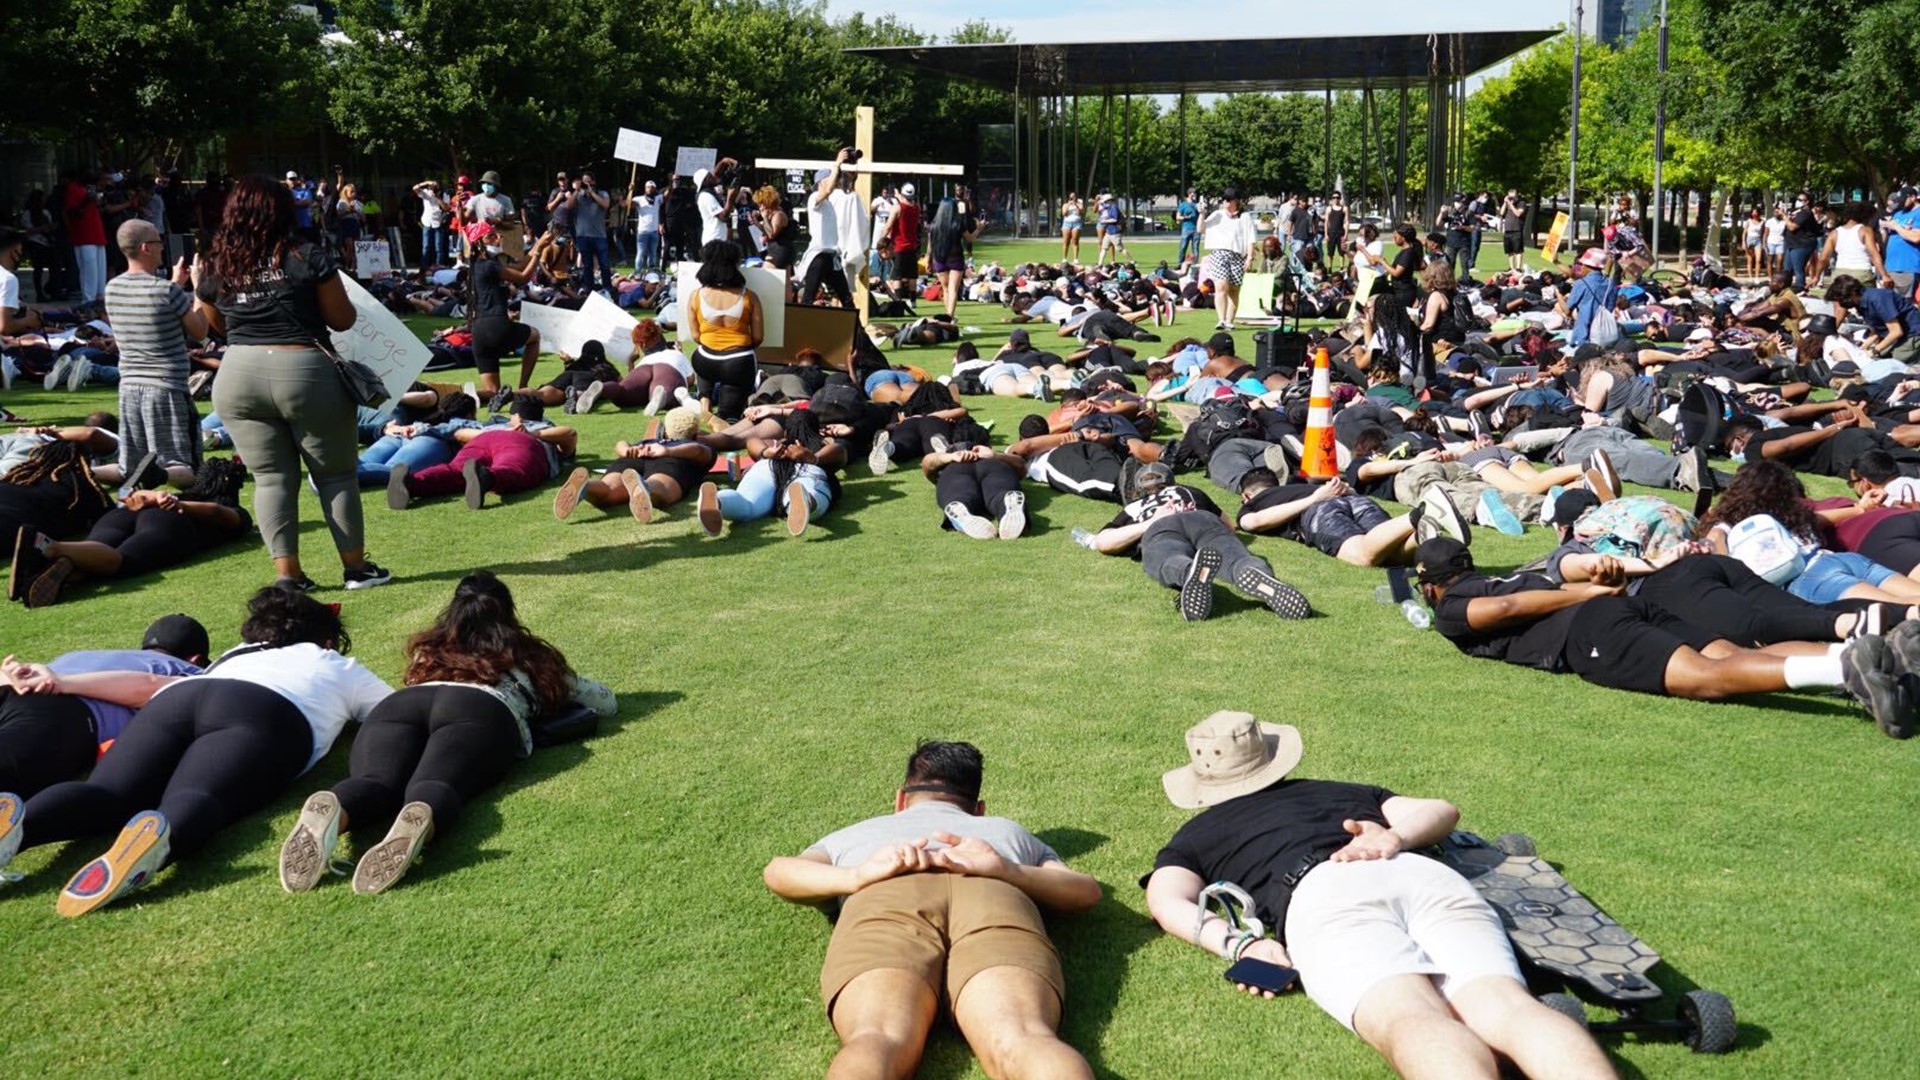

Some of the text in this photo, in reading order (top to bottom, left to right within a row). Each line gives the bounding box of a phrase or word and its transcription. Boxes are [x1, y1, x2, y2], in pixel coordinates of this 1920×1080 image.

[792, 175, 802, 183] NO
[787, 183, 805, 192] PEACE
[353, 314, 409, 367] eorge
